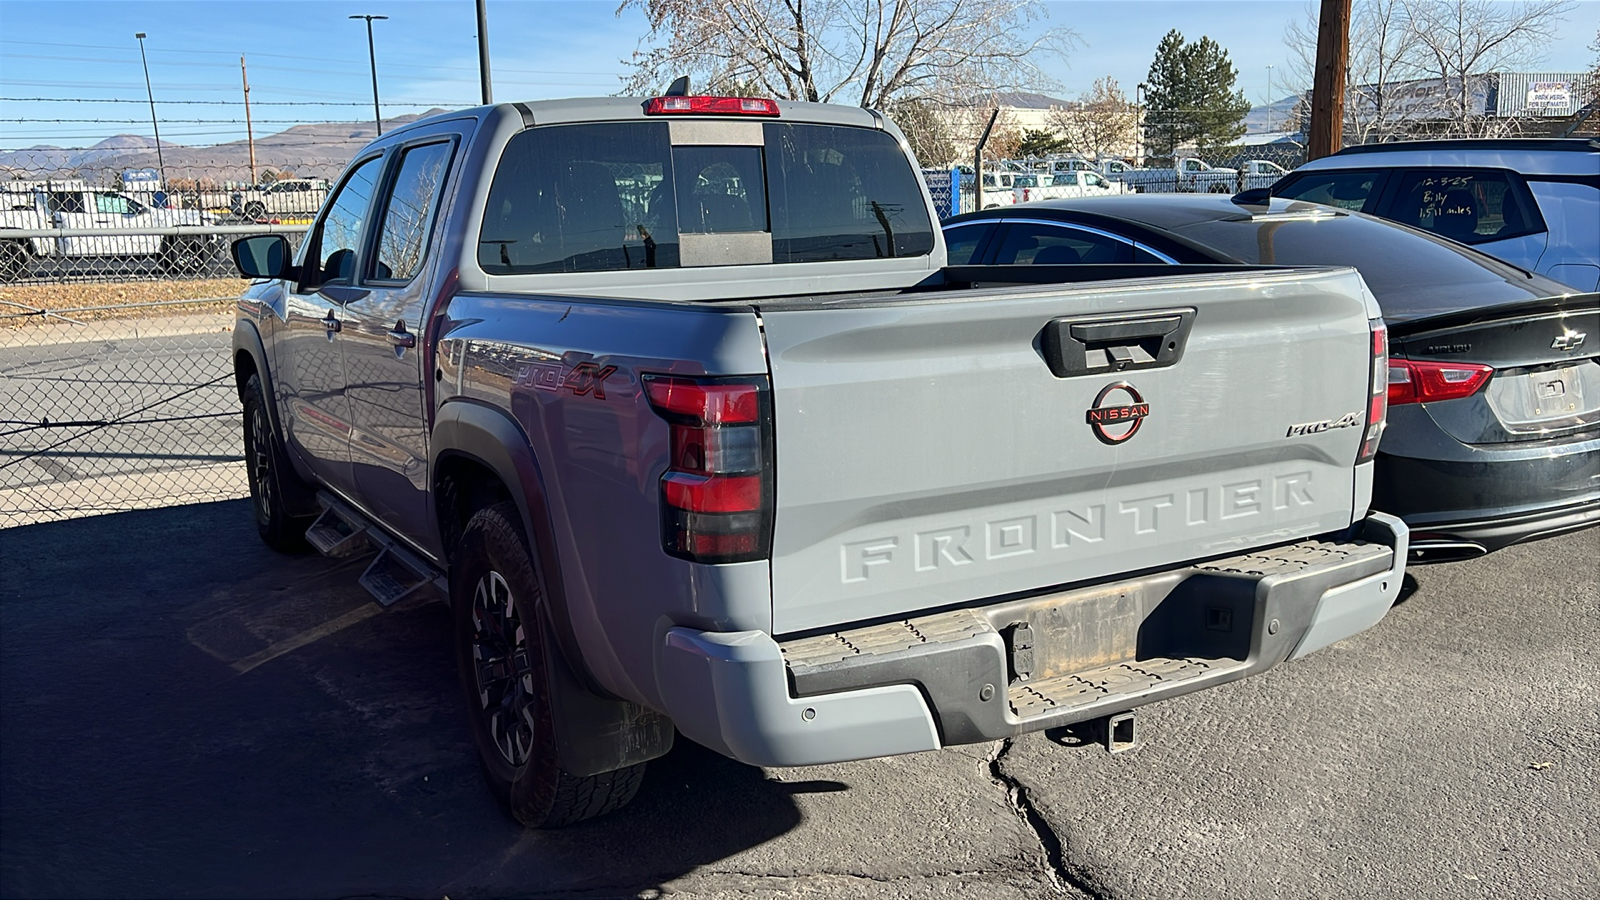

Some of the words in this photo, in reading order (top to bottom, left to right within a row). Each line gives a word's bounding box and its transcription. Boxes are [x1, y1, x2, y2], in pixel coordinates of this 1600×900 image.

[1421, 176, 1474, 187] 12-3-25
[1423, 190, 1448, 207] Billy
[1446, 206, 1472, 216] miles
[1090, 405, 1149, 421] NISSAN
[840, 470, 1315, 584] FRONTIER
